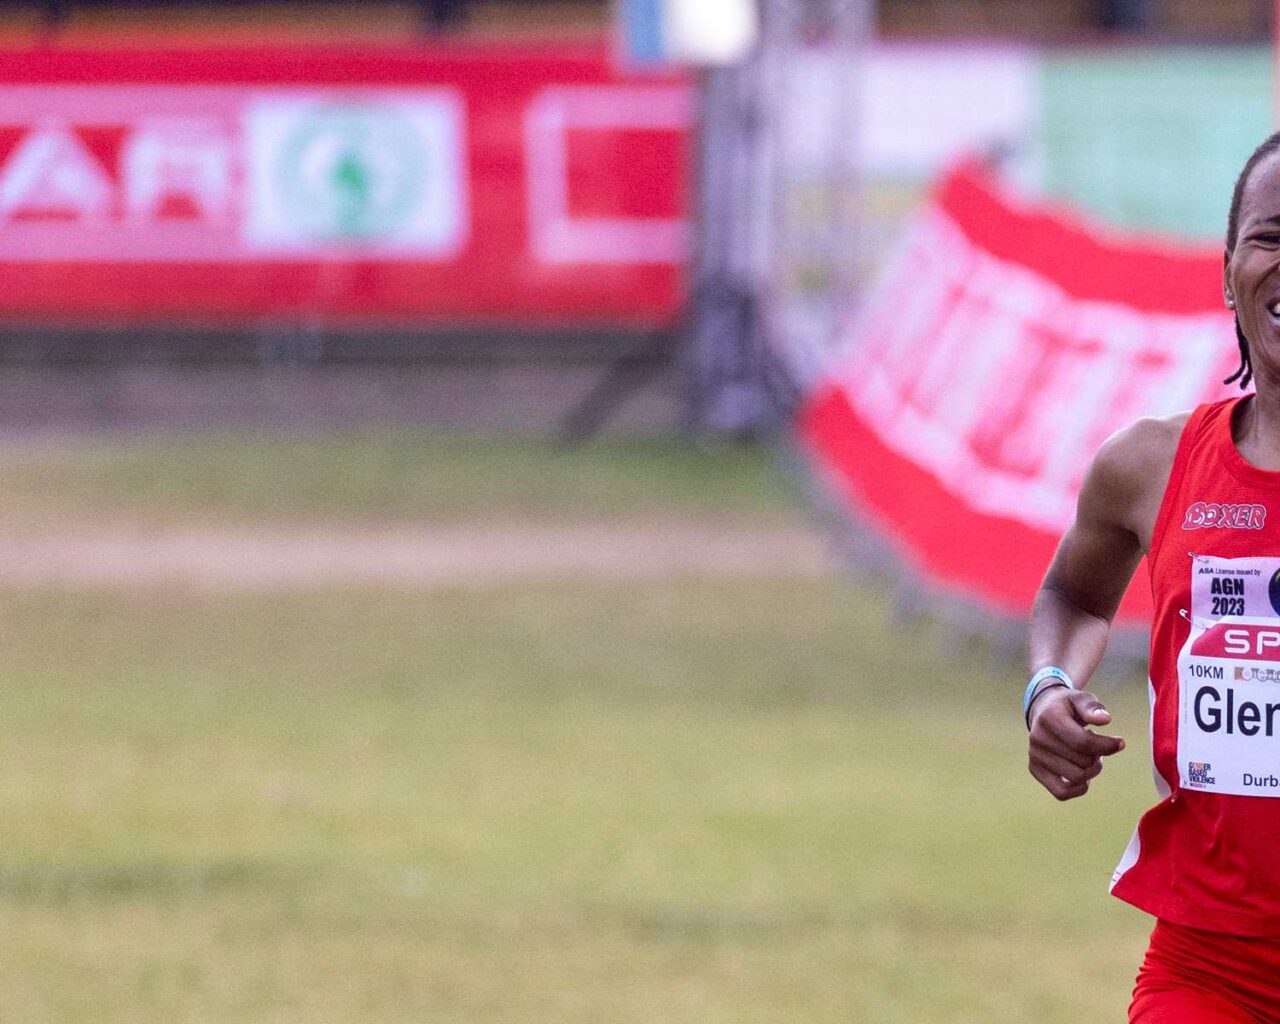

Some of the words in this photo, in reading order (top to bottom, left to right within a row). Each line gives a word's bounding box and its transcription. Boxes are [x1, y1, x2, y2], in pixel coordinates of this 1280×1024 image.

[1182, 502, 1267, 530] BOXER
[1198, 567, 1214, 575] ASA
[1254, 569, 1261, 577] by
[1211, 577, 1245, 596] AGN
[1211, 597, 1245, 616] 2023
[1188, 664, 1224, 680] 10KM
